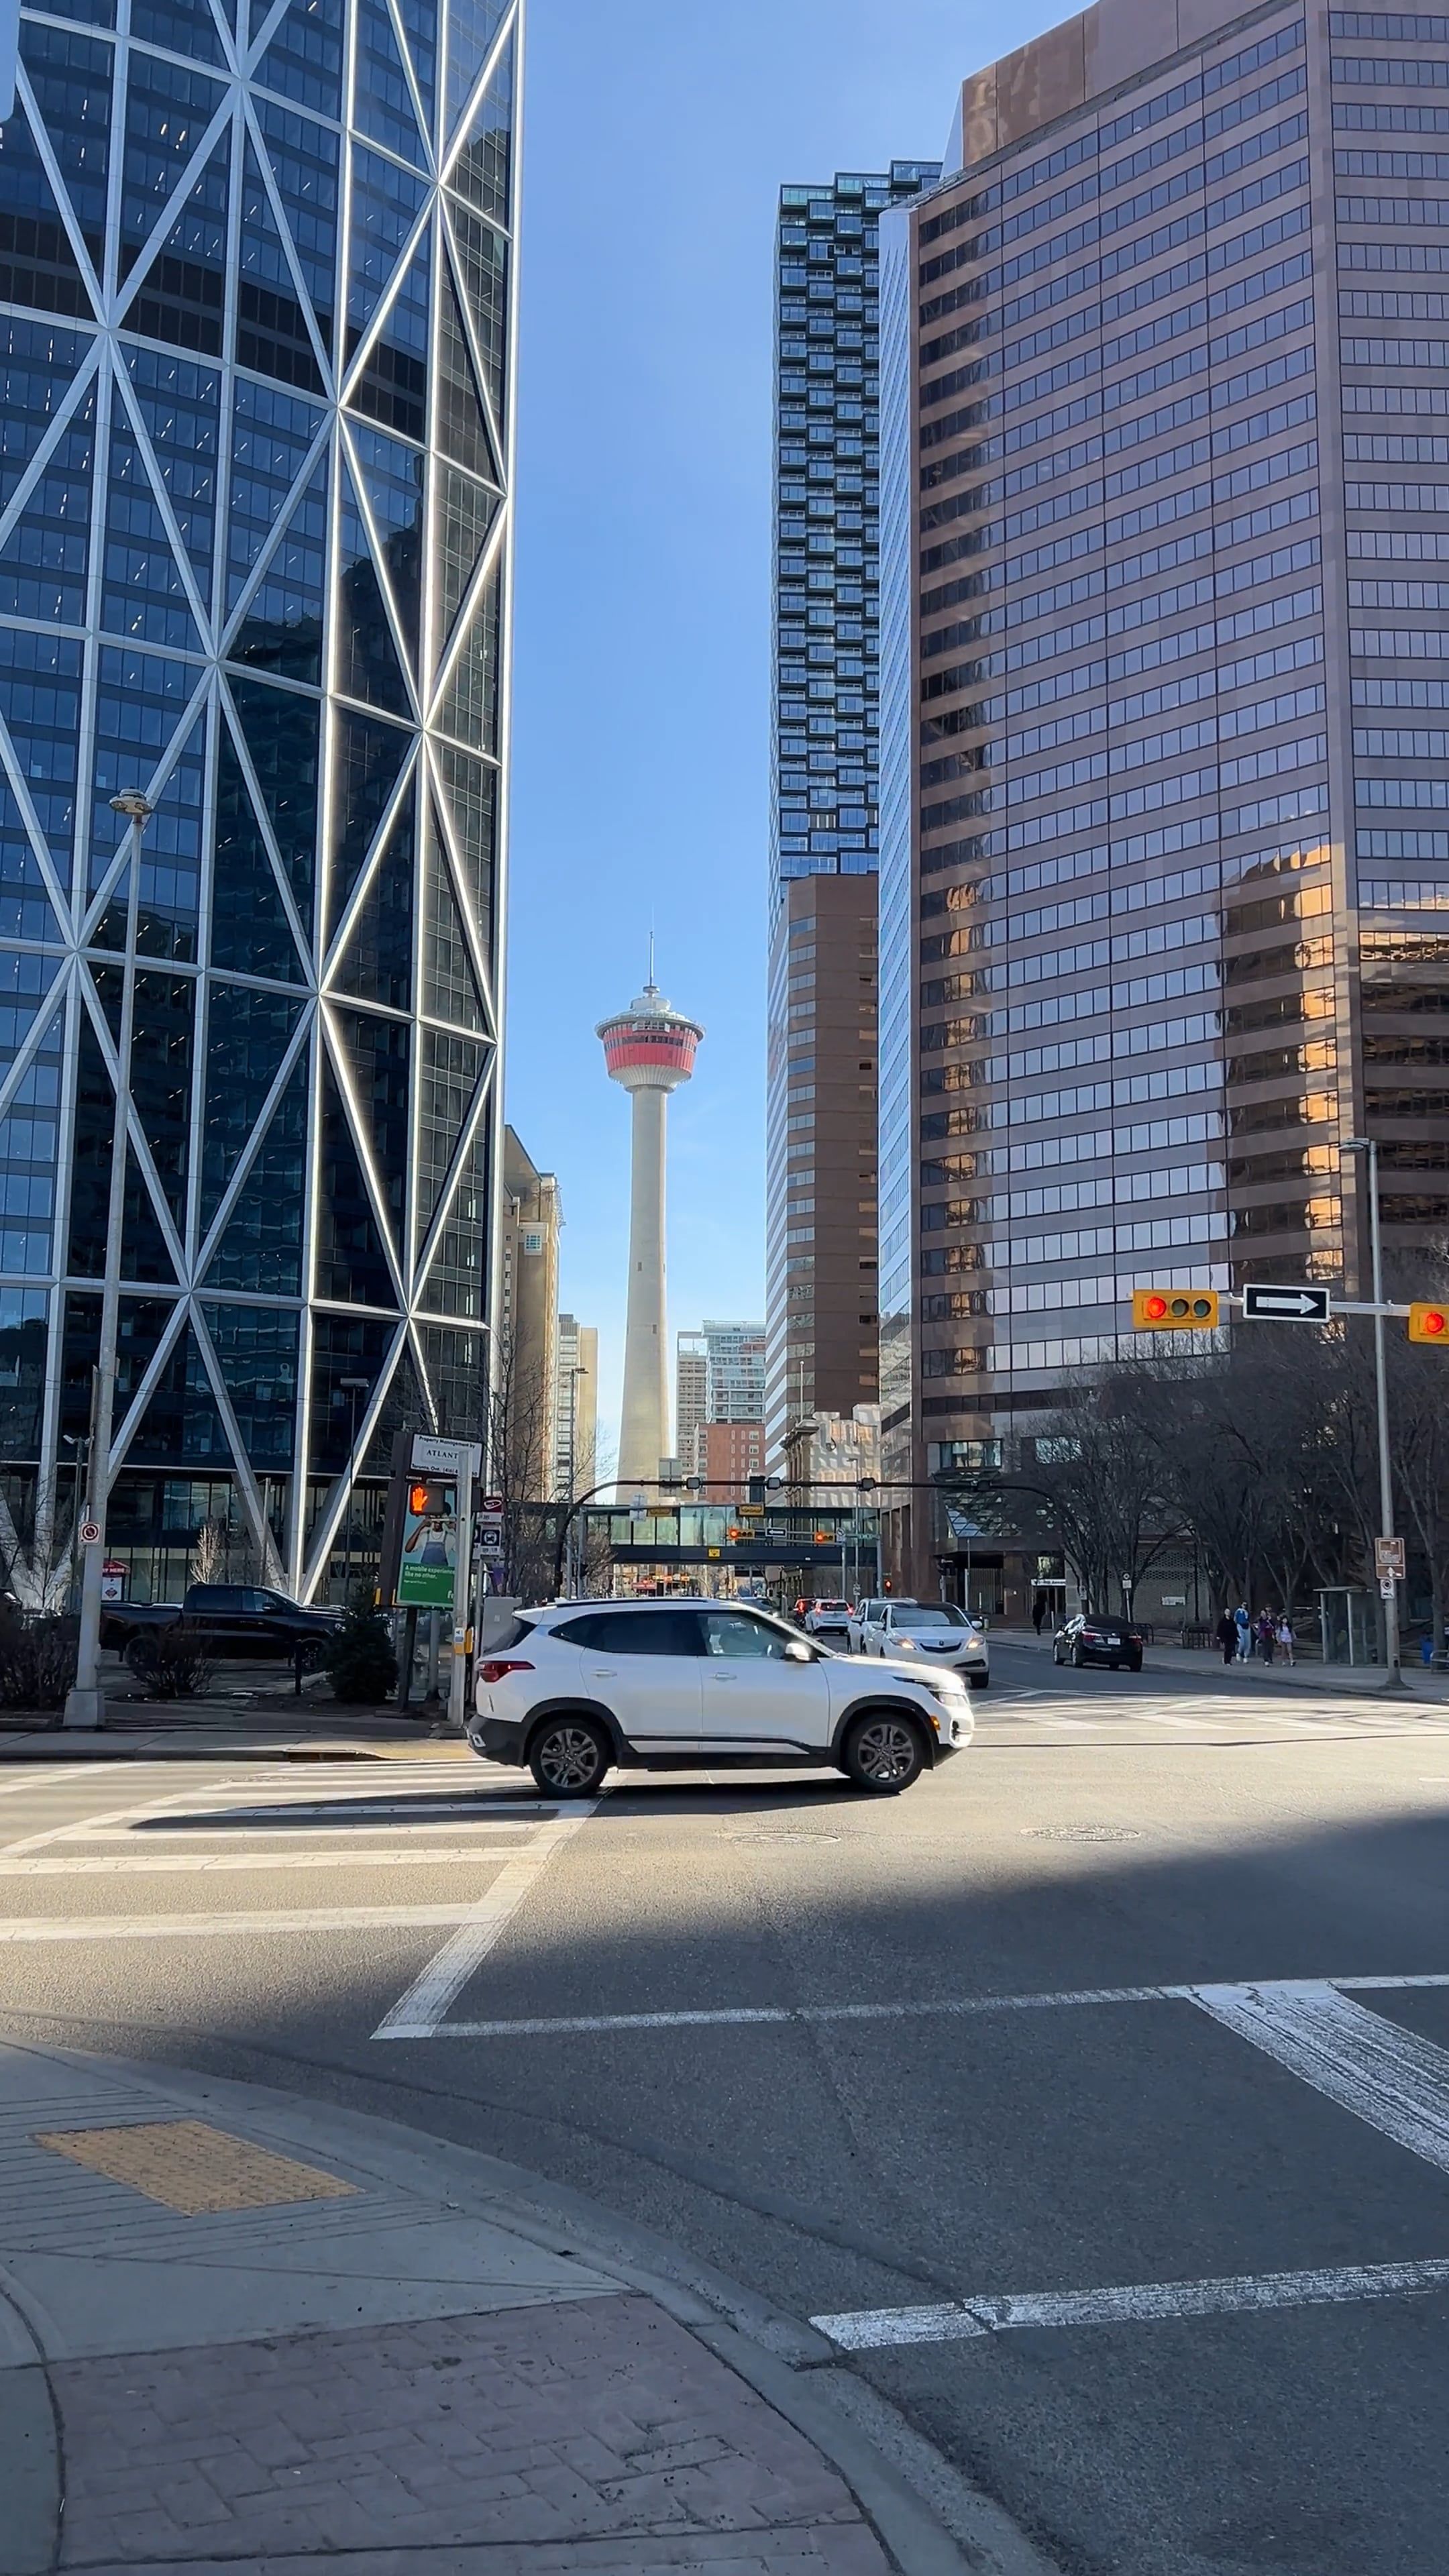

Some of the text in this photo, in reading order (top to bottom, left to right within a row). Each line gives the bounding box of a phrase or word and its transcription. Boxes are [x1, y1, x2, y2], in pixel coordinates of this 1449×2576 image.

[419, 1436, 439, 1444] Property
[440, 1439, 469, 1447] Management
[427, 1450, 458, 1459] ATLANT
